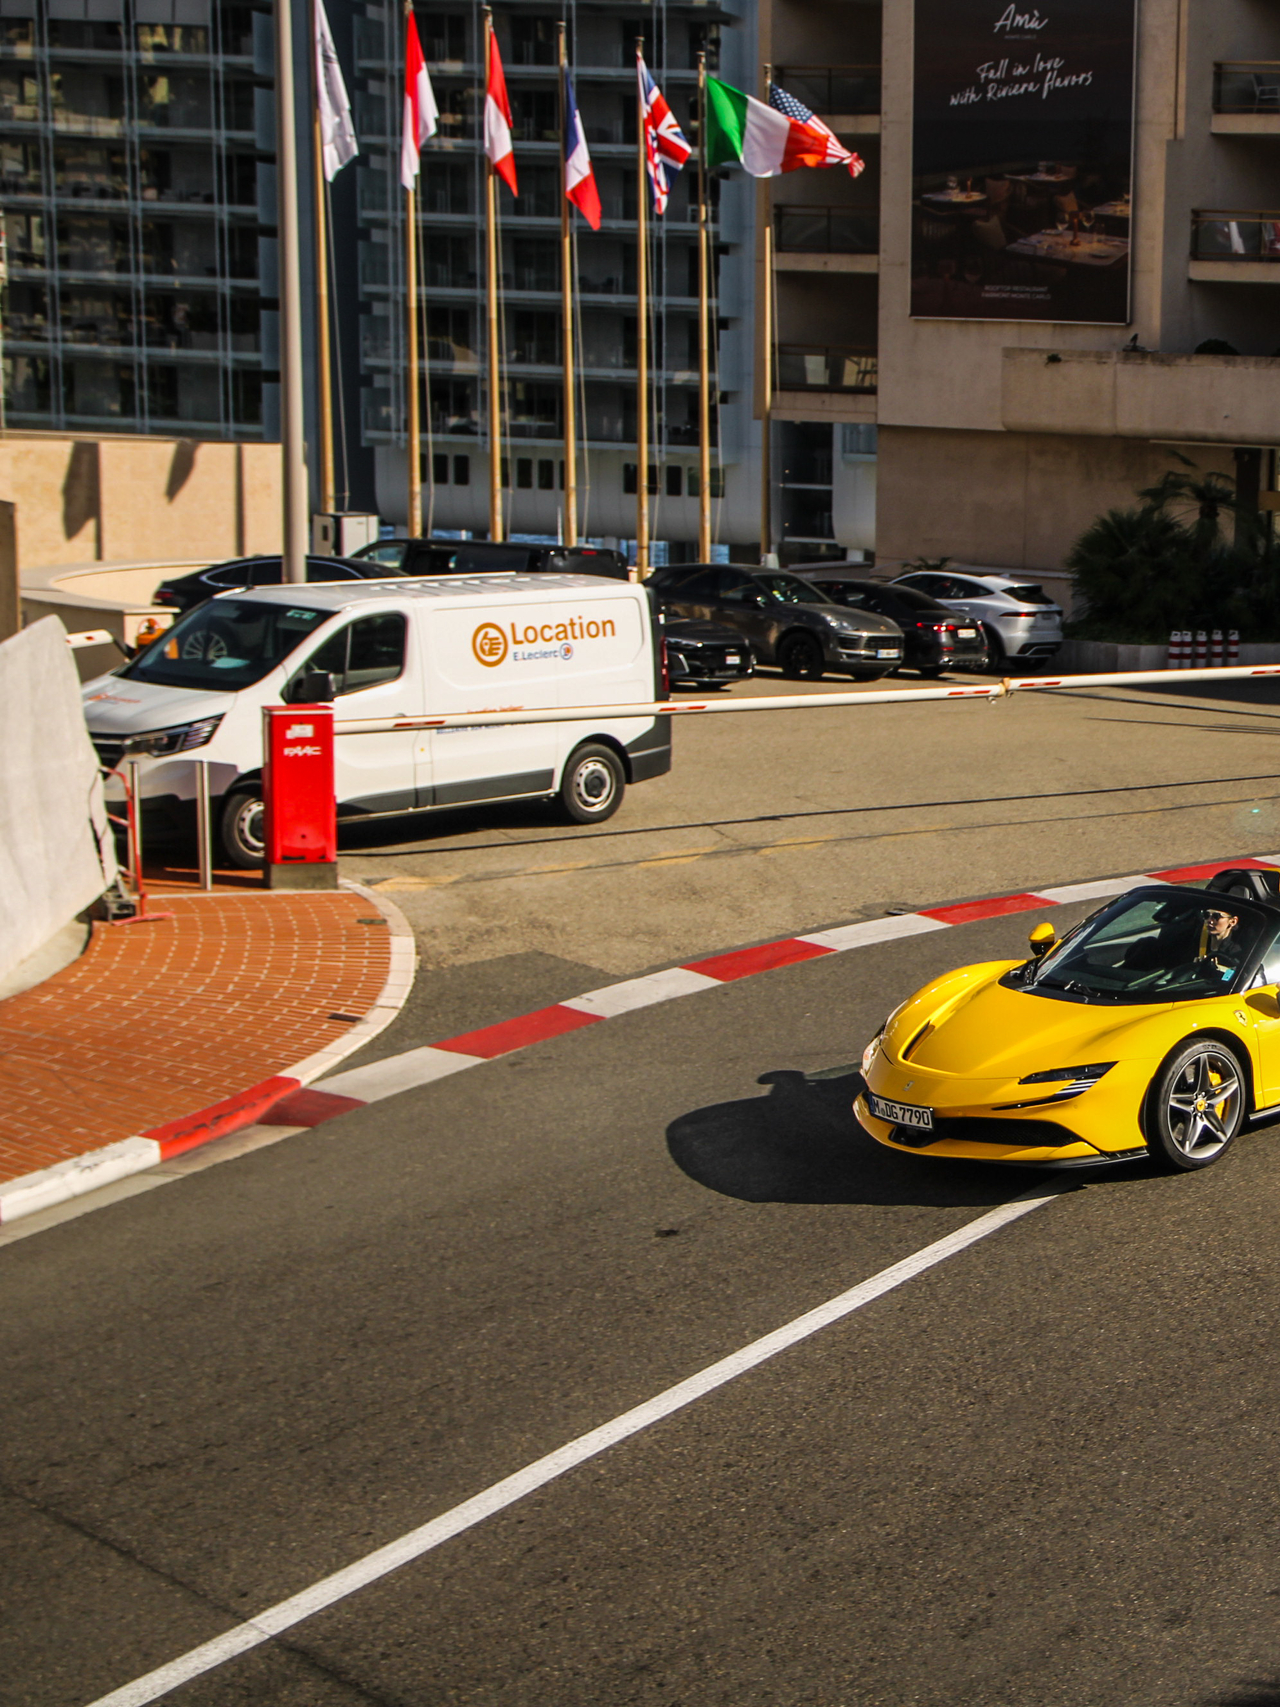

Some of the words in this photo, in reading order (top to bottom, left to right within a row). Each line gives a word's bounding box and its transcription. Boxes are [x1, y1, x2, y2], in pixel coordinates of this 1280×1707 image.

[976, 58, 1009, 83] Fall
[1012, 62, 1030, 76] in
[1033, 52, 1065, 73] love
[950, 86, 982, 106] with
[986, 82, 1040, 101] Riviera
[1042, 69, 1093, 100] flavors
[511, 615, 616, 645] Location
